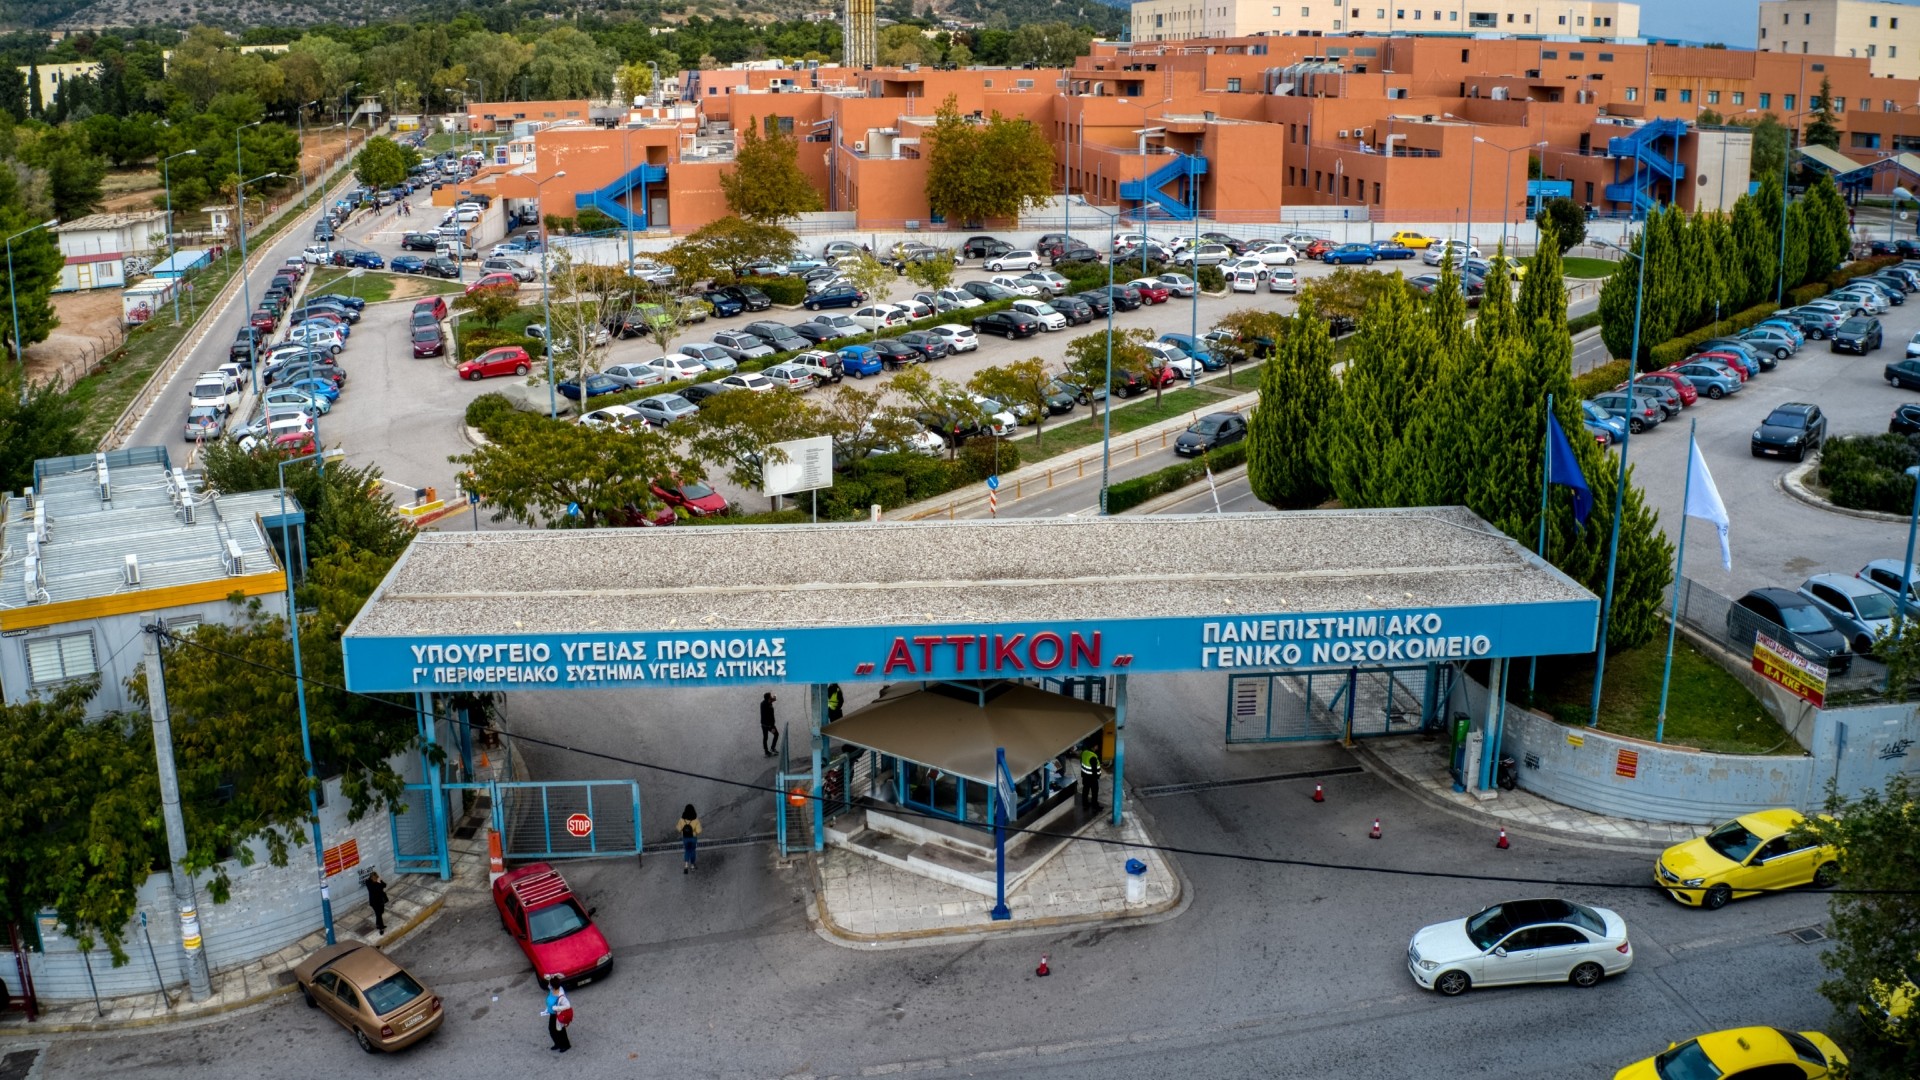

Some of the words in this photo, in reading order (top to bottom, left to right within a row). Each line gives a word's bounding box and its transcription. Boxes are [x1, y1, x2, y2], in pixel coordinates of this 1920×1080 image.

[1203, 613, 1442, 643] ΠΑΝΕΠΙΣΤΗΜΙΑΚΟ
[411, 643, 551, 664] ΥΠΟΥΡΓΕΙΟ
[561, 641, 647, 662] ΥΓΕΙΑΣ
[657, 638, 786, 660] ΠΡΟΝΟΙΑΣ
[1202, 644, 1302, 667] ΓΕΝΙΚΟ
[1312, 635, 1491, 663] ΝΟΣΟΚΟΜΕΙΟ
[434, 665, 558, 684] ΠΕΡΙΦΕΡΕΙΑΚΟ
[566, 663, 645, 681] ΣΥΣΤΗΜΑ
[648, 662, 708, 679] ΥΓΕΙΑΣ
[715, 659, 787, 677] ΑΤΤΙΚΗΣ
[1763, 664, 1780, 681] Μ-Λ
[1781, 674, 1801, 692] ΚΚΕ
[569, 819, 590, 831] STOP
